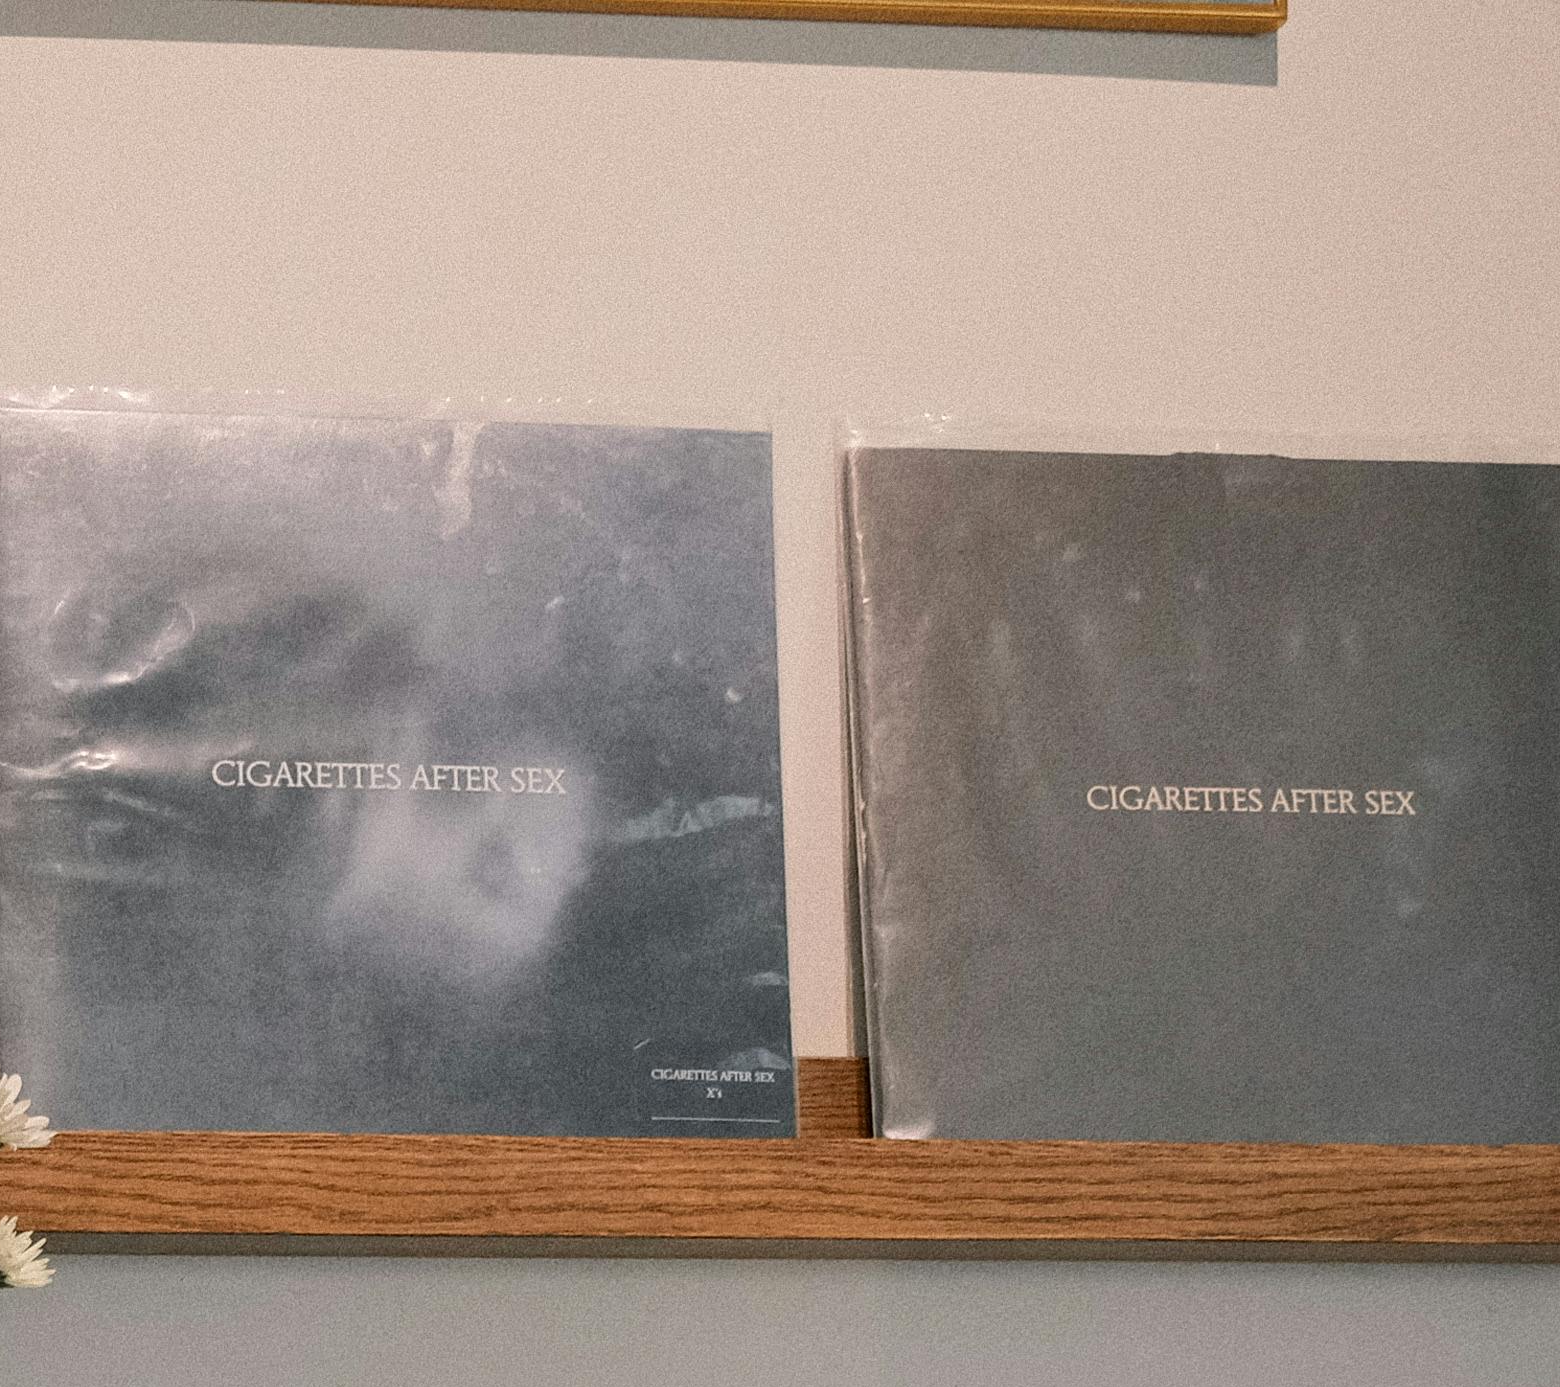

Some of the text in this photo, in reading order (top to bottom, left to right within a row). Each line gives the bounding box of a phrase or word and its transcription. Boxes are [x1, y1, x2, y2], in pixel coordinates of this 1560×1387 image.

[212, 760, 567, 794] CIGARETTES AFTER SEX
[1087, 785, 1416, 816] CIGARETTES AFTER SEX
[651, 1069, 775, 1083] CIGARETTES AFTER SEX
